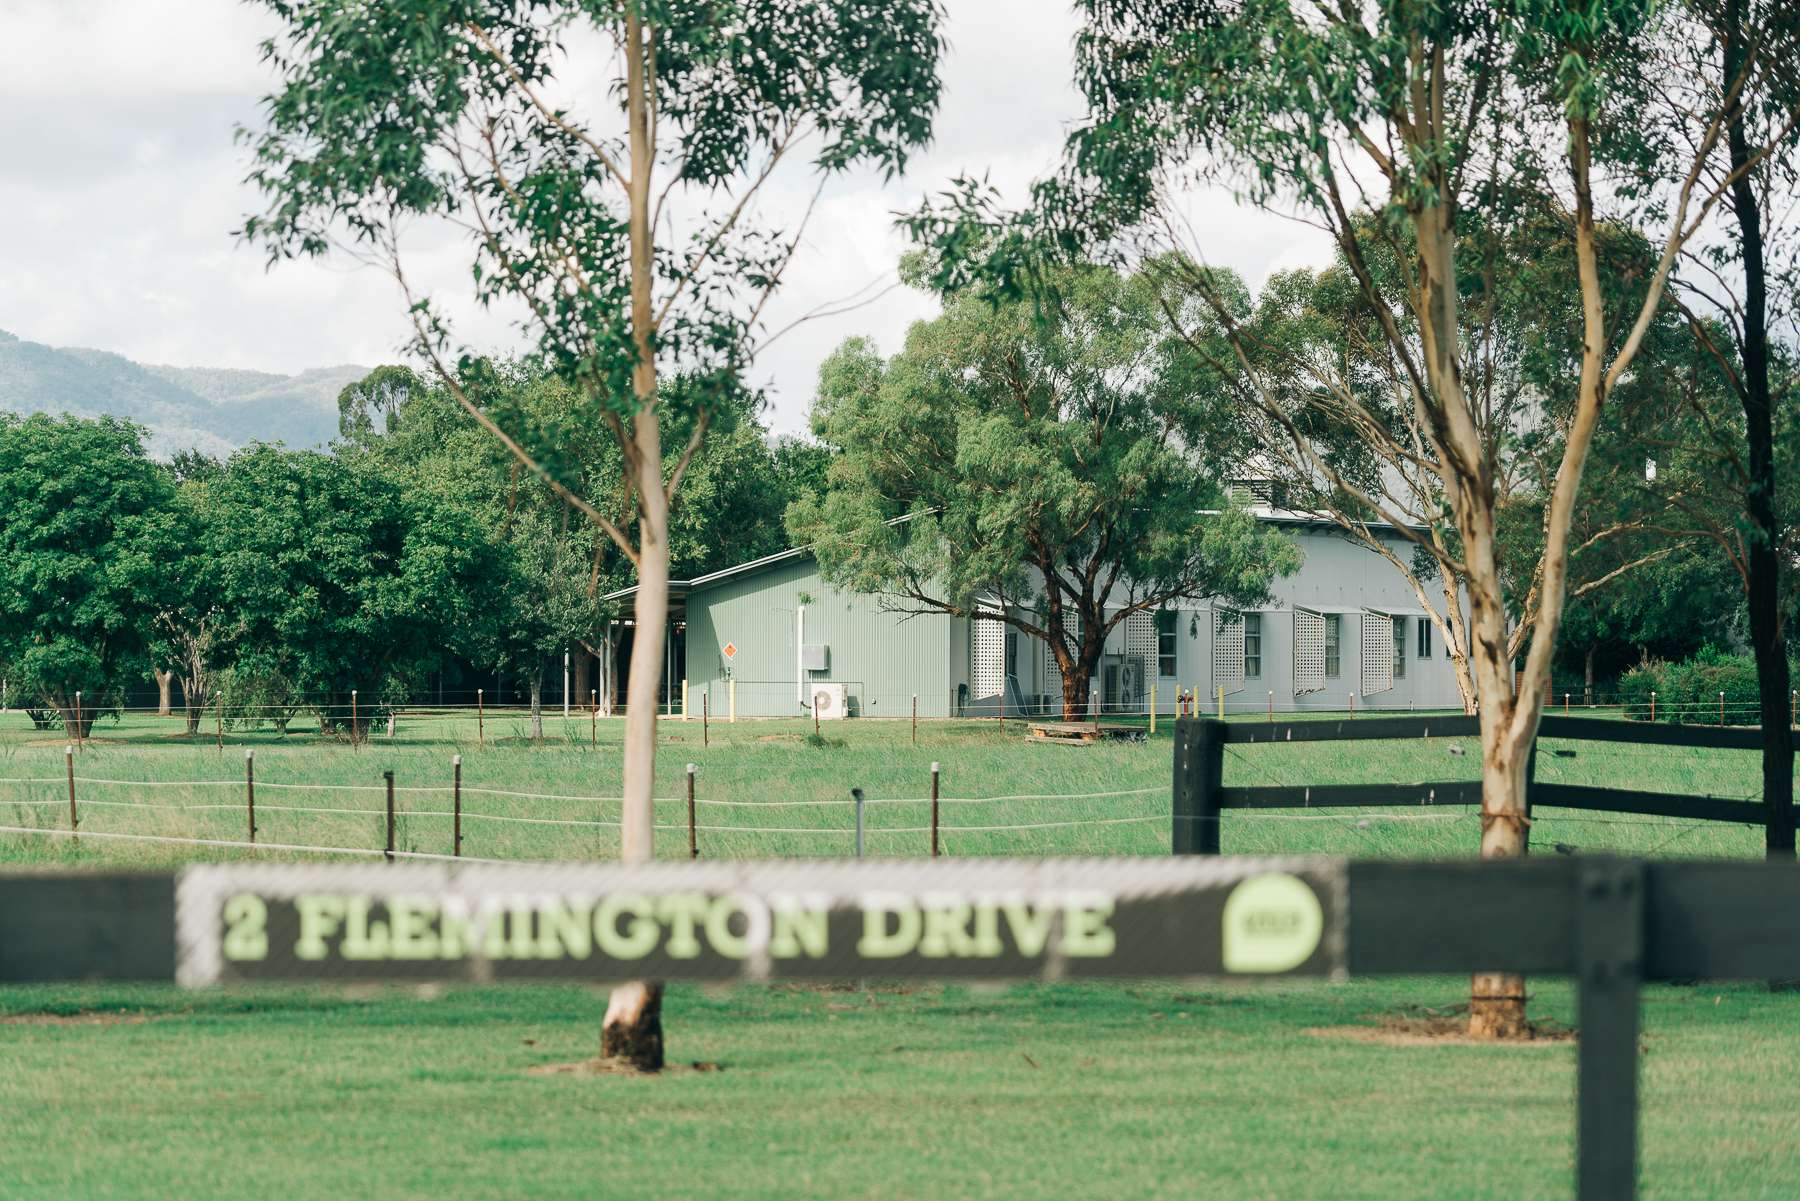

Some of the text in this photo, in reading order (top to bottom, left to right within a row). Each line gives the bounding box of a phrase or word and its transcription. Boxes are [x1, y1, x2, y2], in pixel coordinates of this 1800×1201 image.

[223, 889, 1116, 961] 2 FLEMINGTON DRIVE
